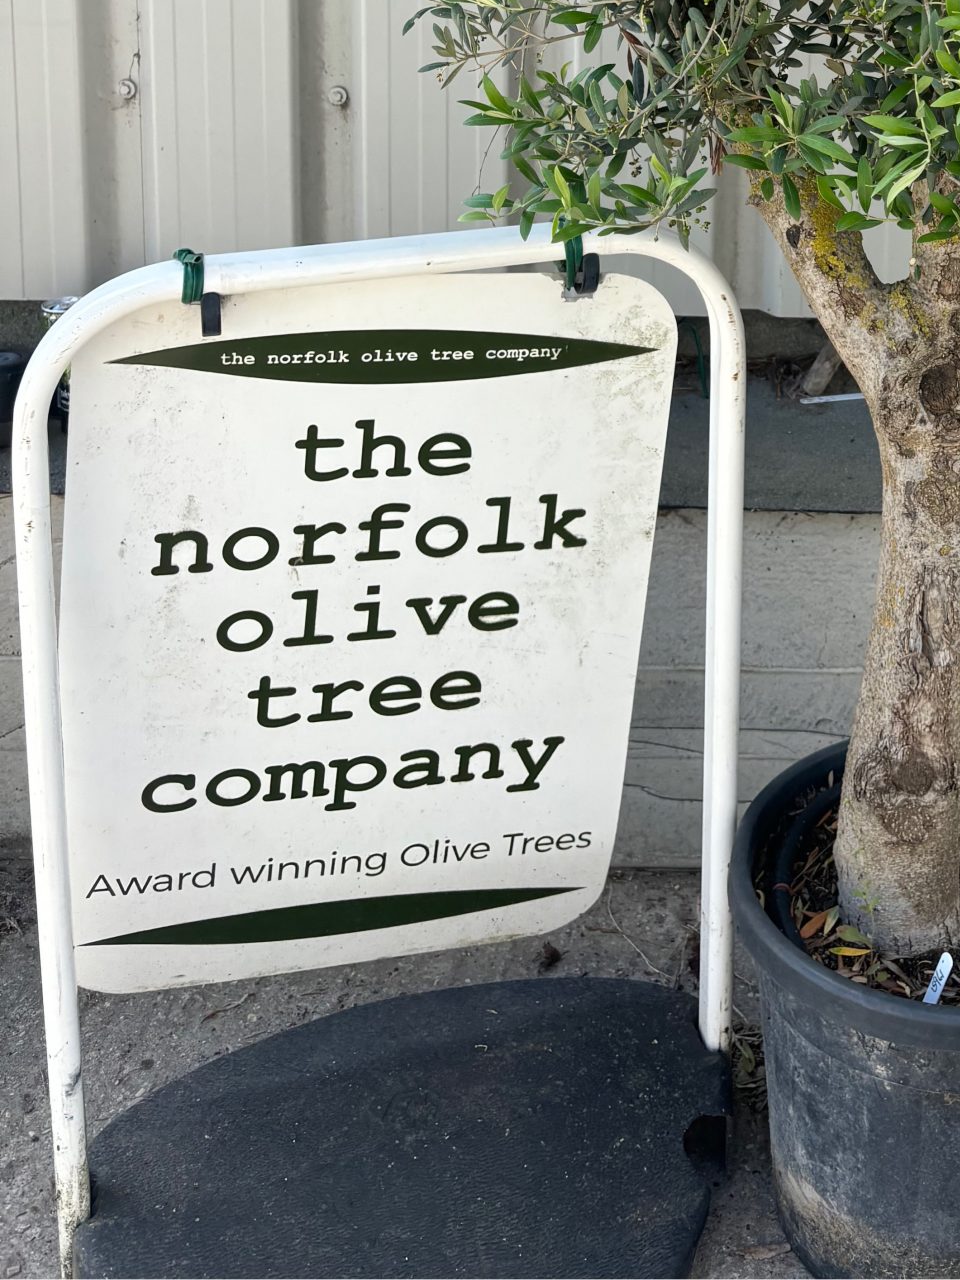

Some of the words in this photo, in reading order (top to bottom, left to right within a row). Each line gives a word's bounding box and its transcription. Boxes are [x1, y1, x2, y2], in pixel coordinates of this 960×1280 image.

[220, 352, 256, 366] the
[267, 350, 350, 365] norfolk
[361, 349, 419, 363] olive
[430, 348, 475, 361] tree
[485, 347, 562, 362] company
[295, 420, 472, 481] the
[151, 494, 587, 576] norfolk
[217, 585, 520, 652] olive
[248, 671, 482, 728] tree
[142, 736, 564, 813] company
[86, 863, 217, 898] Award
[231, 852, 387, 885] winning
[400, 839, 491, 867] Olive
[502, 830, 592, 857] Trees
